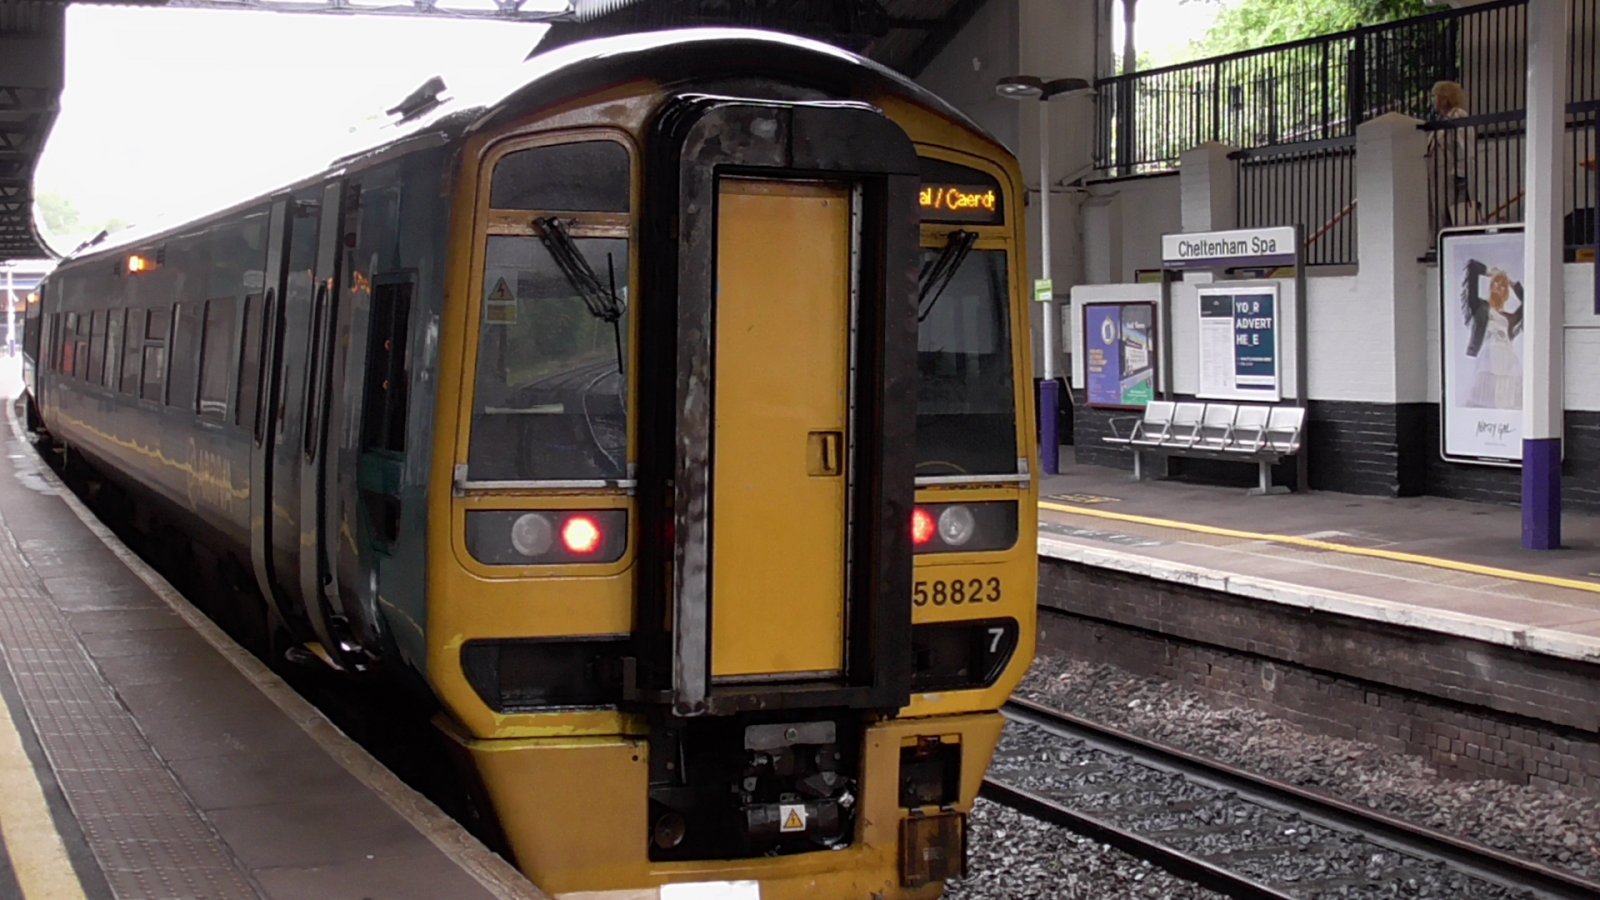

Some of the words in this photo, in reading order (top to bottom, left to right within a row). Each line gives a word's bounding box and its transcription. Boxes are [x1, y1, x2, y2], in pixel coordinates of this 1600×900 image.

[935, 187, 943, 209] /
[1178, 238, 1247, 257] Cheltenham
[1251, 236, 1276, 256] Spa
[1235, 318, 1272, 329] ADVERT
[913, 576, 1002, 607] 58823
[988, 627, 1004, 653] 7
